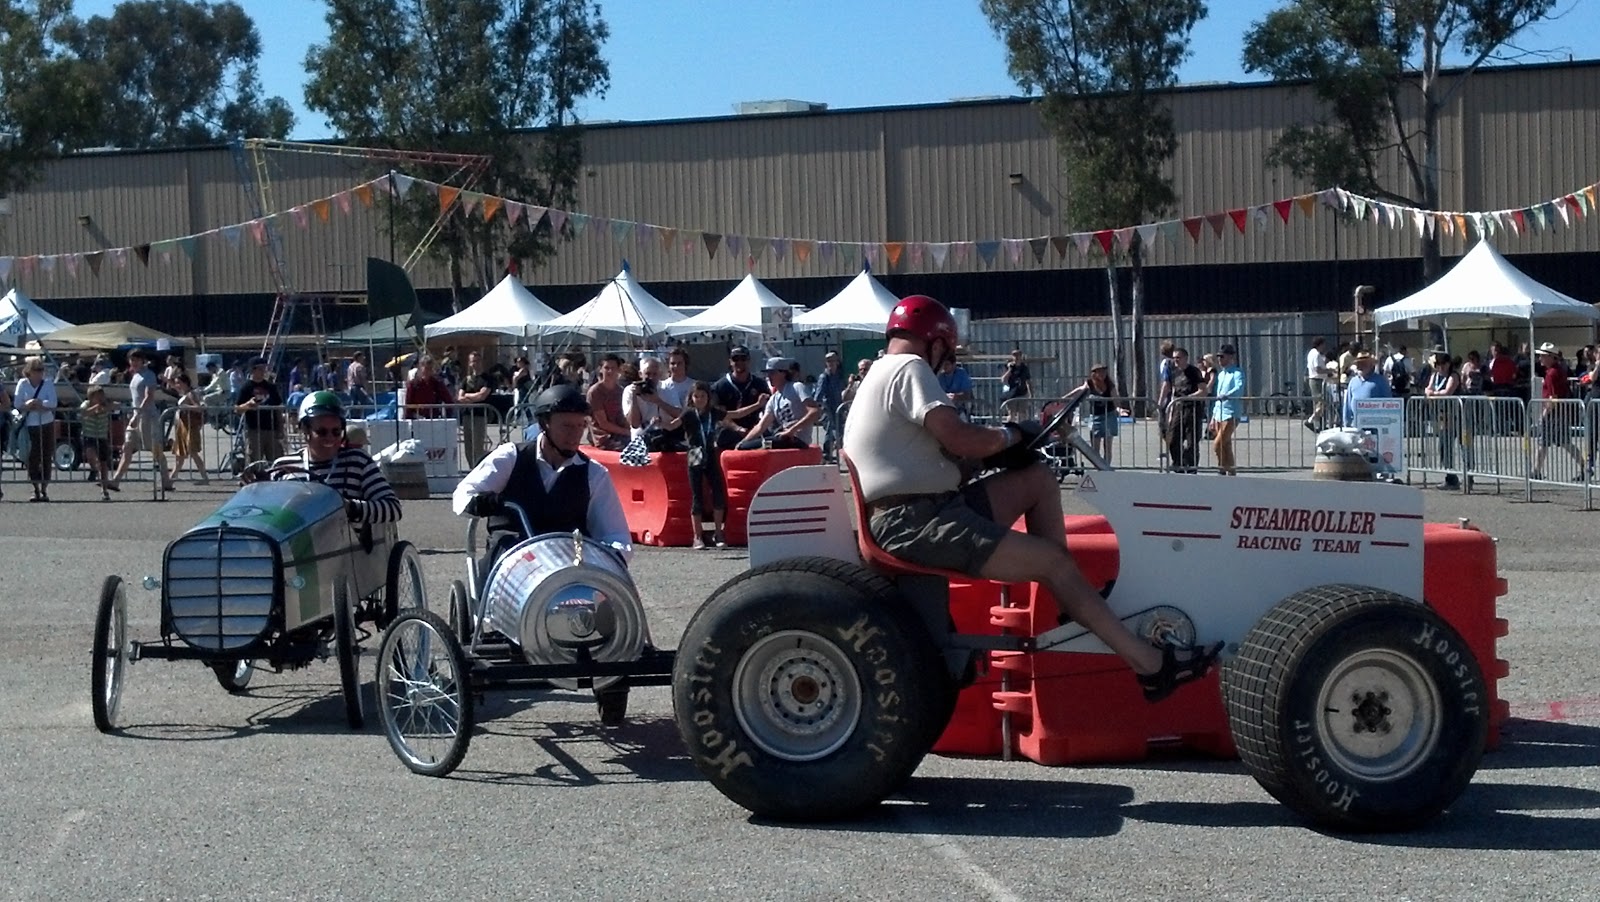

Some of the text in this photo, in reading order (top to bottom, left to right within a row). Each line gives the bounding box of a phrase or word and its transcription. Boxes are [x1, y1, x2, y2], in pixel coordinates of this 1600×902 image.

[1230, 506, 1376, 535] STEAMROLLER
[1237, 535, 1361, 554] RACING TEAM
[683, 636, 755, 780] Hoosier
[1414, 622, 1480, 716] Hoosier
[1295, 719, 1360, 812] Hoosier
